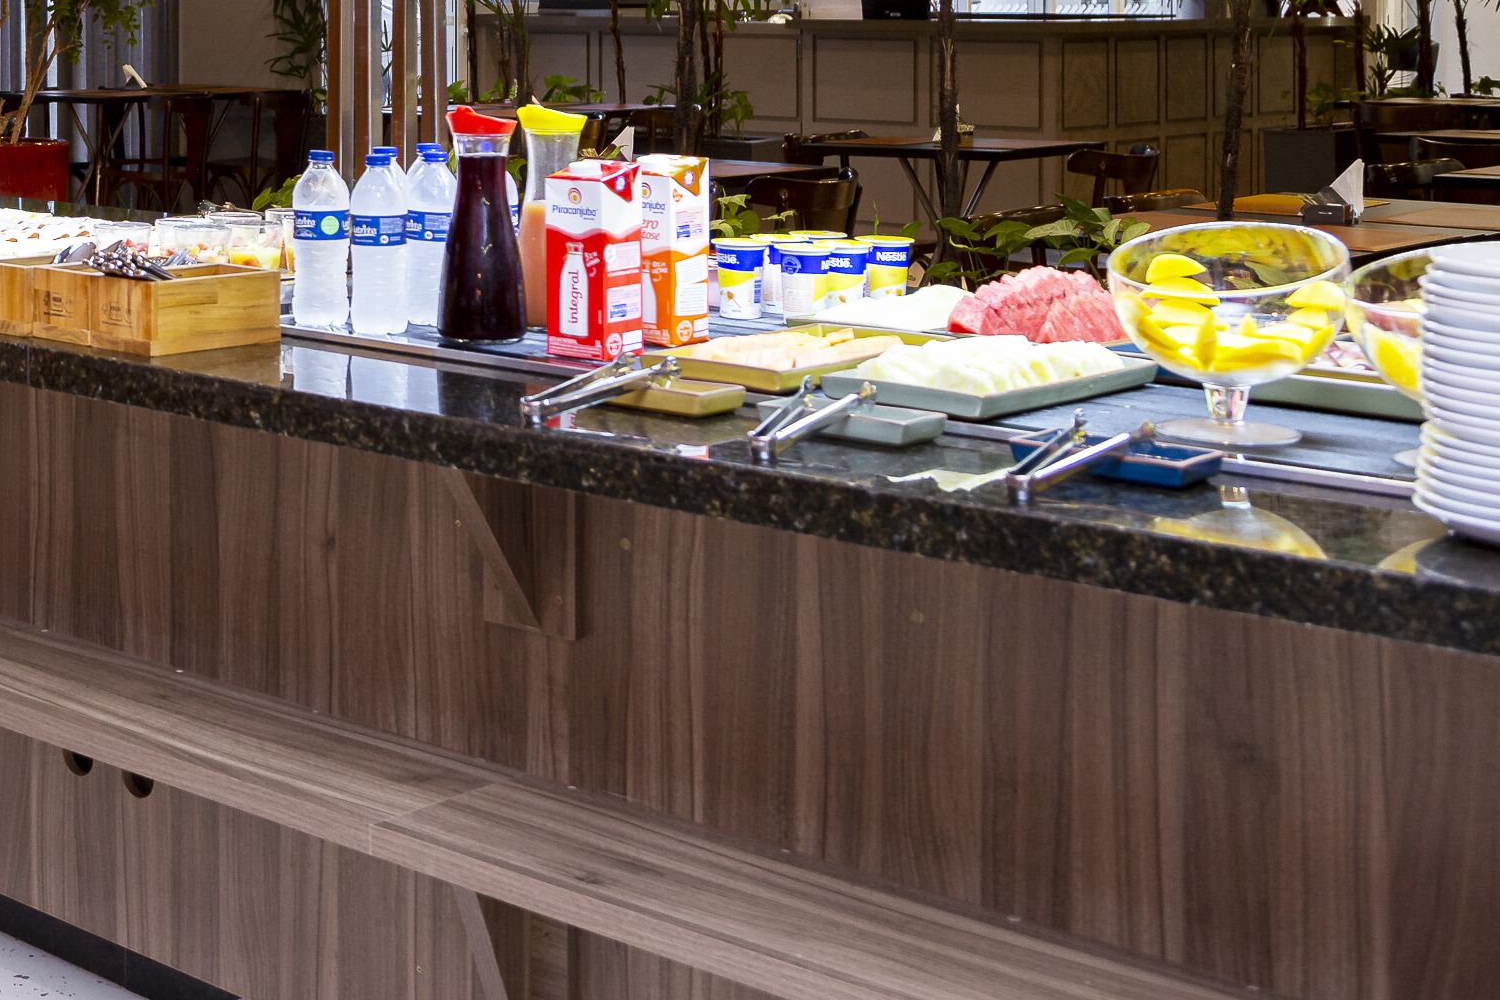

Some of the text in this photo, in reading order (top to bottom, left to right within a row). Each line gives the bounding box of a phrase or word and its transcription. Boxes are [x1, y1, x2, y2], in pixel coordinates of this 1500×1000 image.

[552, 204, 597, 218] Piracanjuba
[642, 201, 666, 215] anjuba
[641, 218, 659, 230] ero
[567, 269, 583, 324] integral
